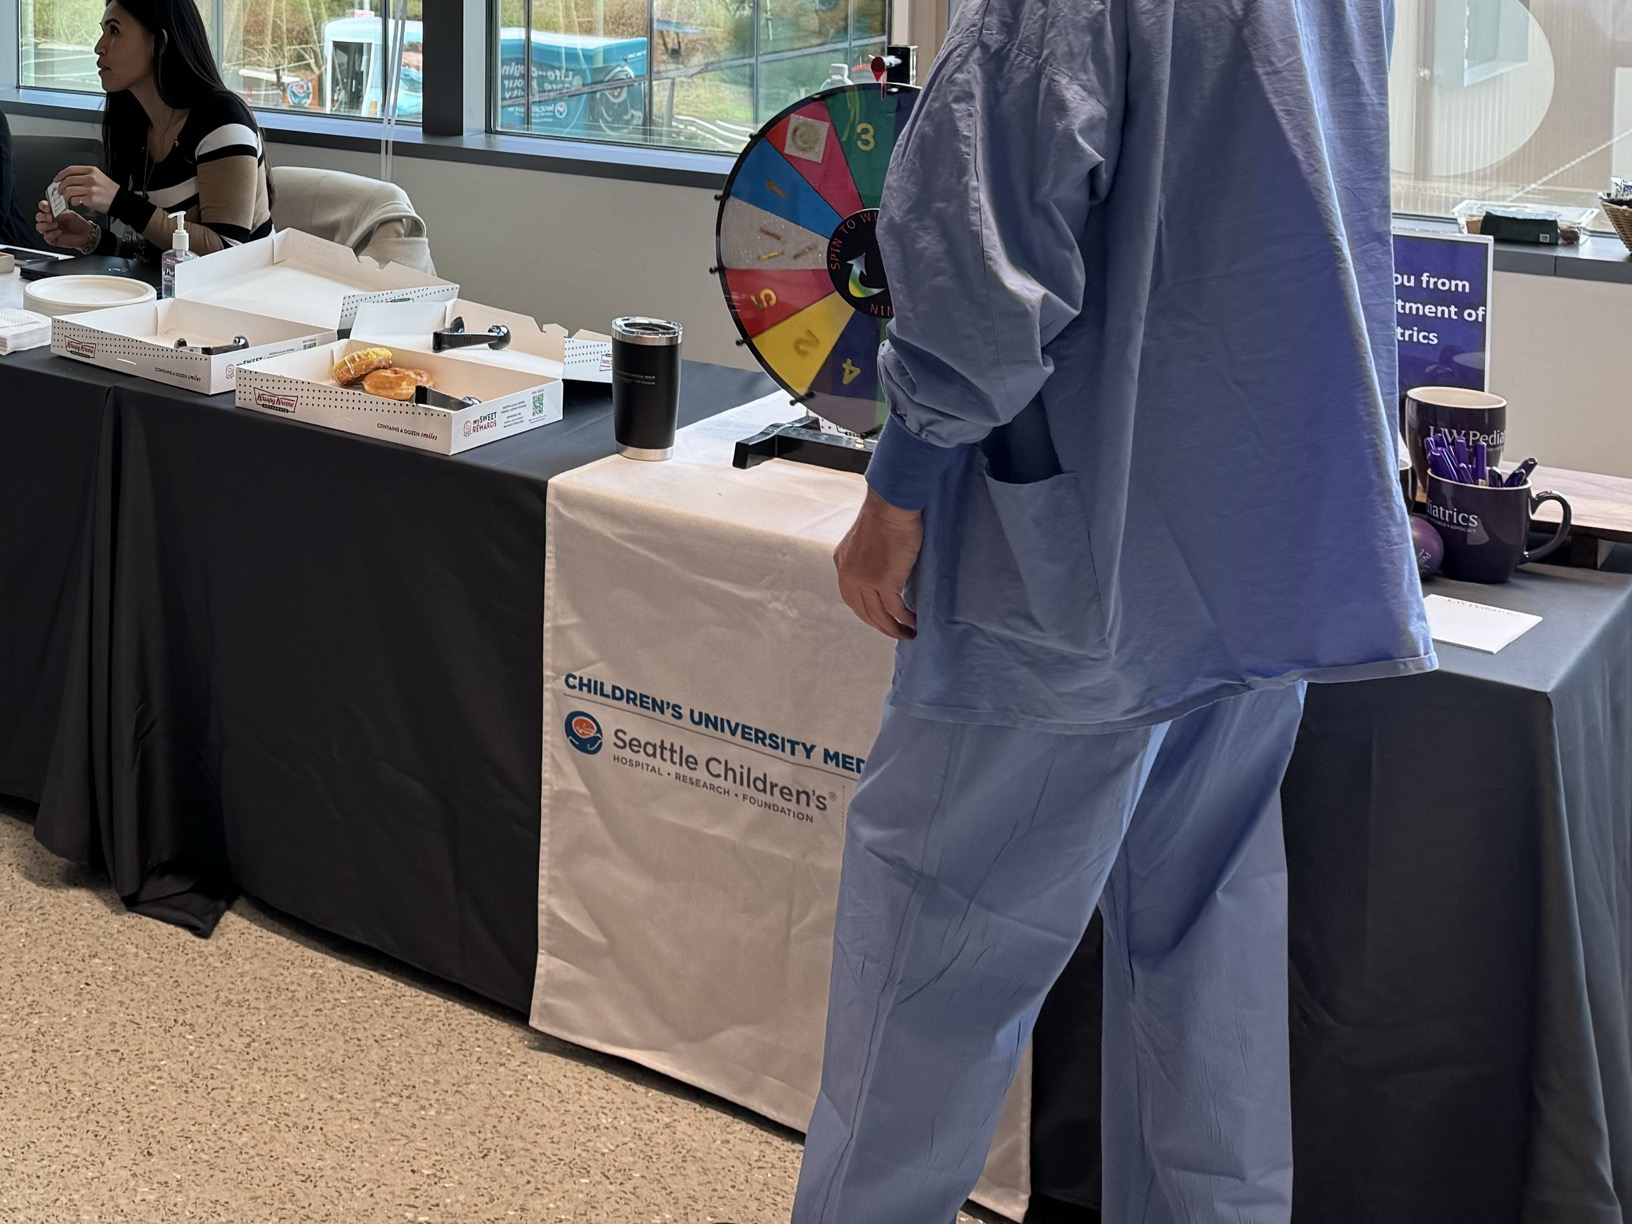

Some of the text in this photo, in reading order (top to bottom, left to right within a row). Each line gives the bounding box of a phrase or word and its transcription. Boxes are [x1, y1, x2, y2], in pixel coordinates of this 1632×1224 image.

[855, 122, 876, 152] 3
[830, 238, 843, 270] SPIN
[838, 219, 856, 234] TO
[1421, 272, 1470, 293] from
[1463, 306, 1486, 322] of
[1395, 326, 1439, 345] trics
[376, 423, 399, 434] CONTAINS
[403, 429, 420, 437] DOZEN
[564, 672, 684, 721] CHILDREN'S
[689, 708, 817, 761] UNIVERSITY
[613, 728, 828, 812] Seattle Children's
[613, 753, 815, 824] HOSPITAL RESEARCH FOUNDATION
